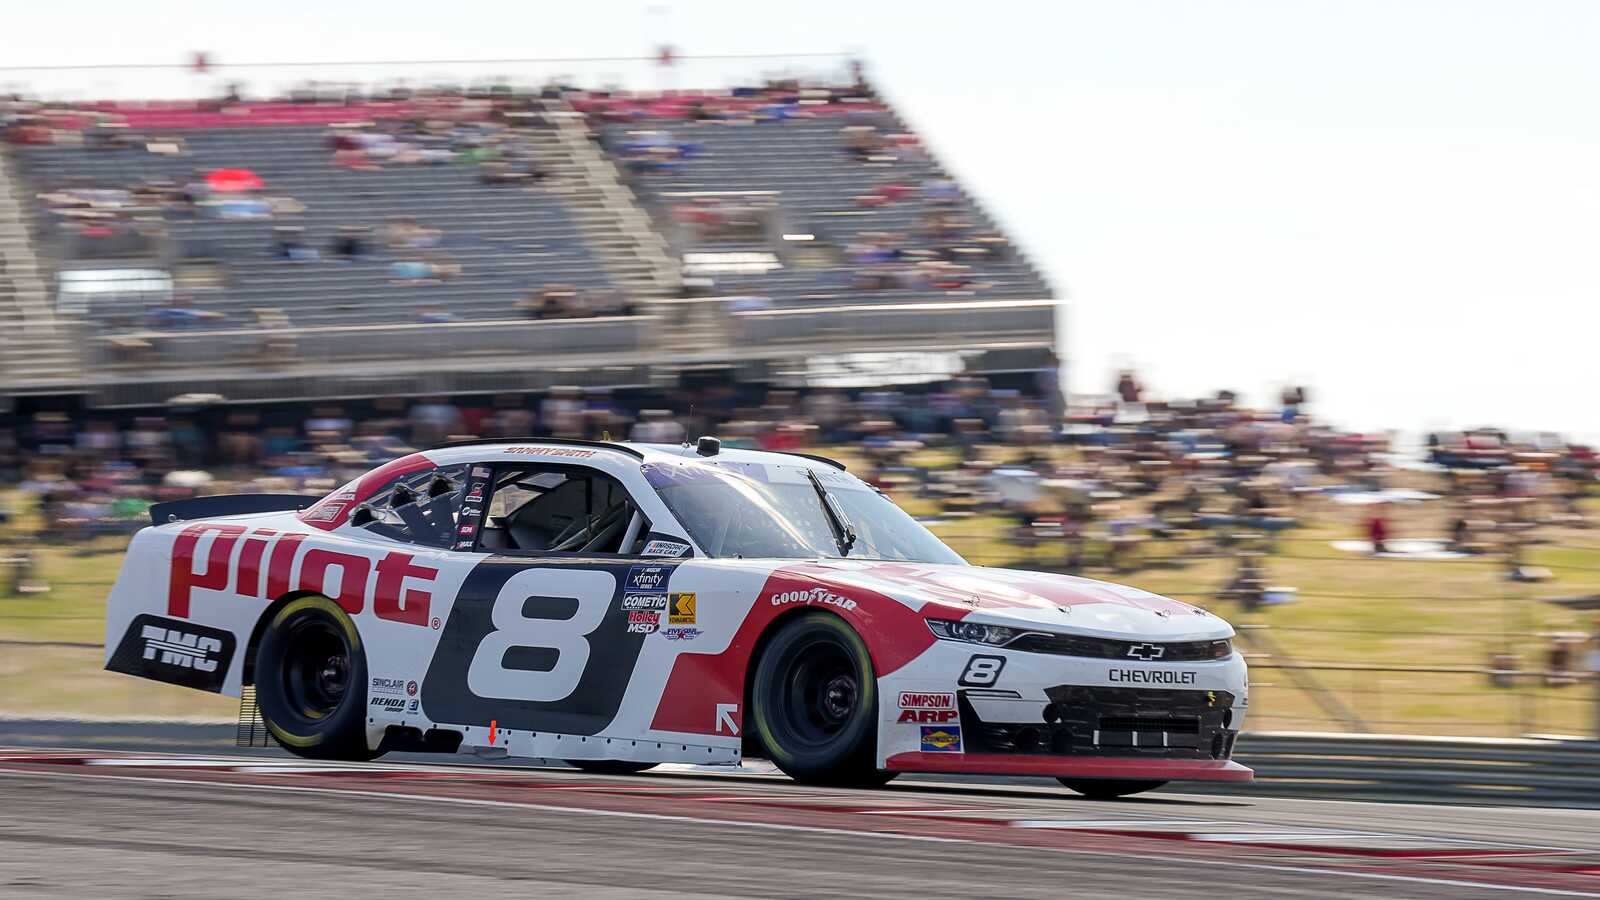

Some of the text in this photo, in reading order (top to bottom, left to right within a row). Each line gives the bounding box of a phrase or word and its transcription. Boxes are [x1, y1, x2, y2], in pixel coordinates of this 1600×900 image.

[168, 524, 438, 627] pilot
[633, 572, 663, 586] xfinity
[624, 595, 667, 607] COMETIC
[771, 588, 857, 611] GOODYEAR
[629, 612, 658, 625] Holley
[467, 567, 617, 702] 8
[627, 623, 655, 633] MSD
[141, 624, 222, 672] TMC
[964, 657, 1001, 683] 8
[1108, 669, 1197, 684] CHEVROLET
[372, 678, 404, 688] SINCLAIR
[370, 697, 406, 707] RENDA
[901, 694, 951, 707] SIMPSON
[897, 710, 959, 723] ARP
